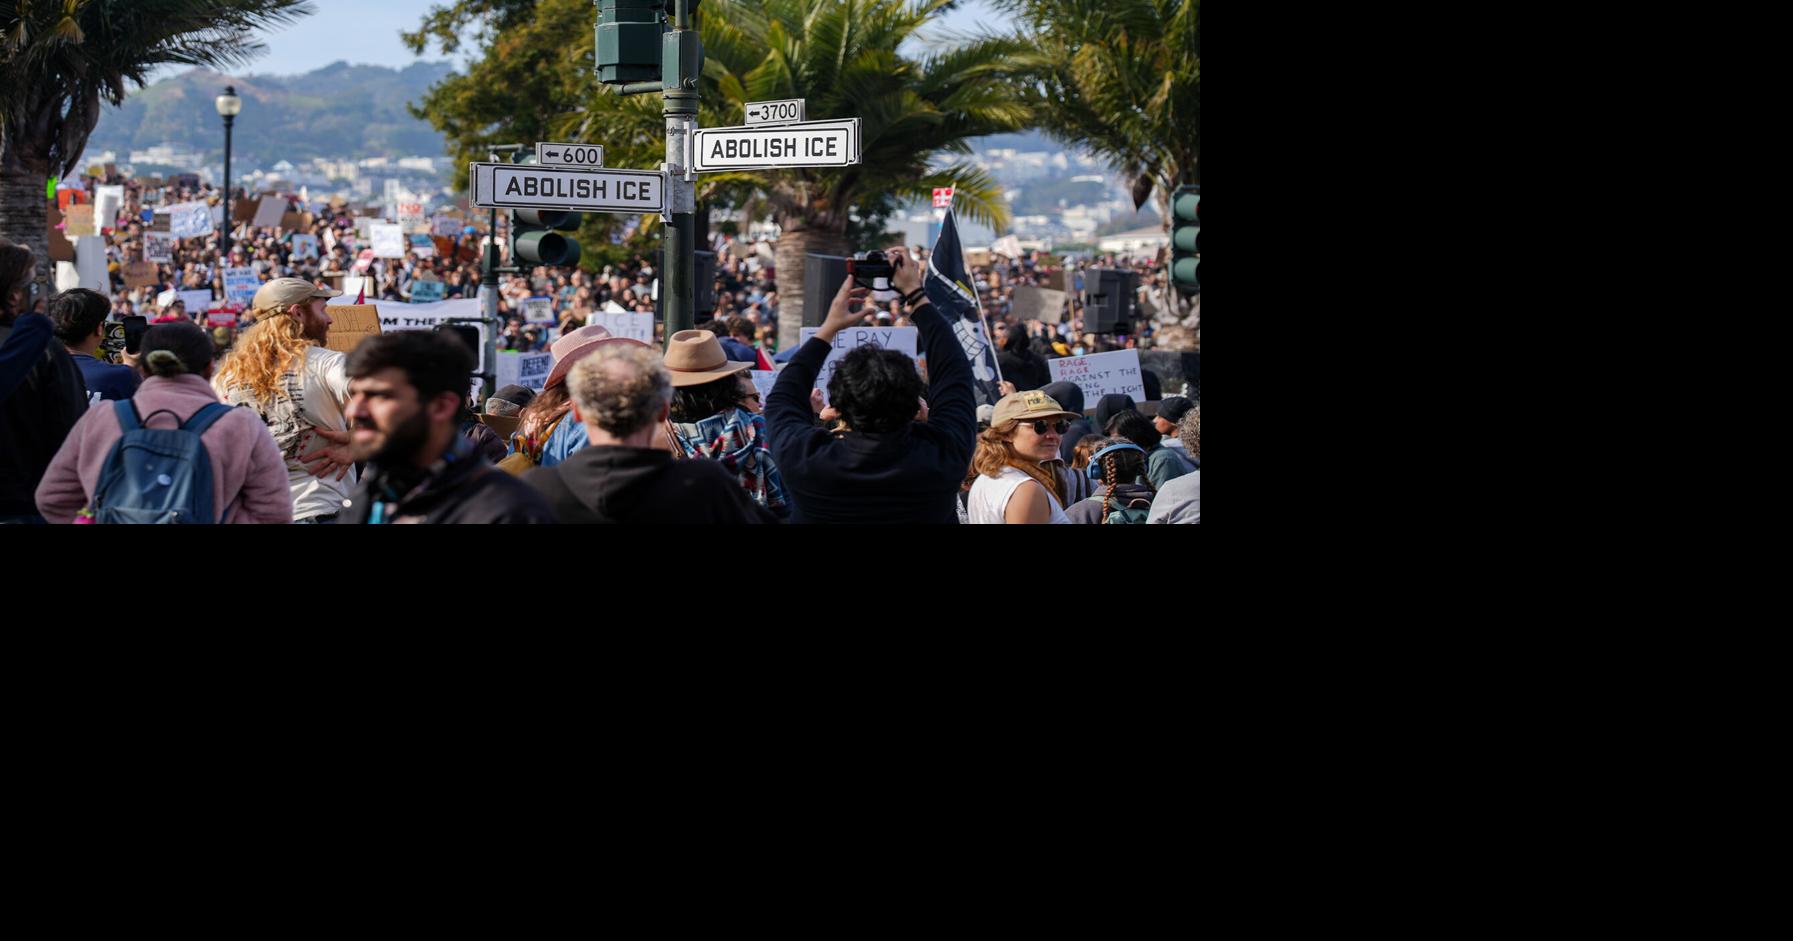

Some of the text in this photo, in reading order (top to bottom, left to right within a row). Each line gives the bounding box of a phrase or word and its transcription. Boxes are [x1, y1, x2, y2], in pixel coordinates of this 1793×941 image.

[761, 102, 797, 121] 3700
[562, 147, 598, 164] 600
[710, 136, 838, 160] ABOLISH ICE
[505, 176, 651, 201] ABOLISH ICE
[403, 317, 437, 326] THE
[1119, 367, 1137, 377] THE
